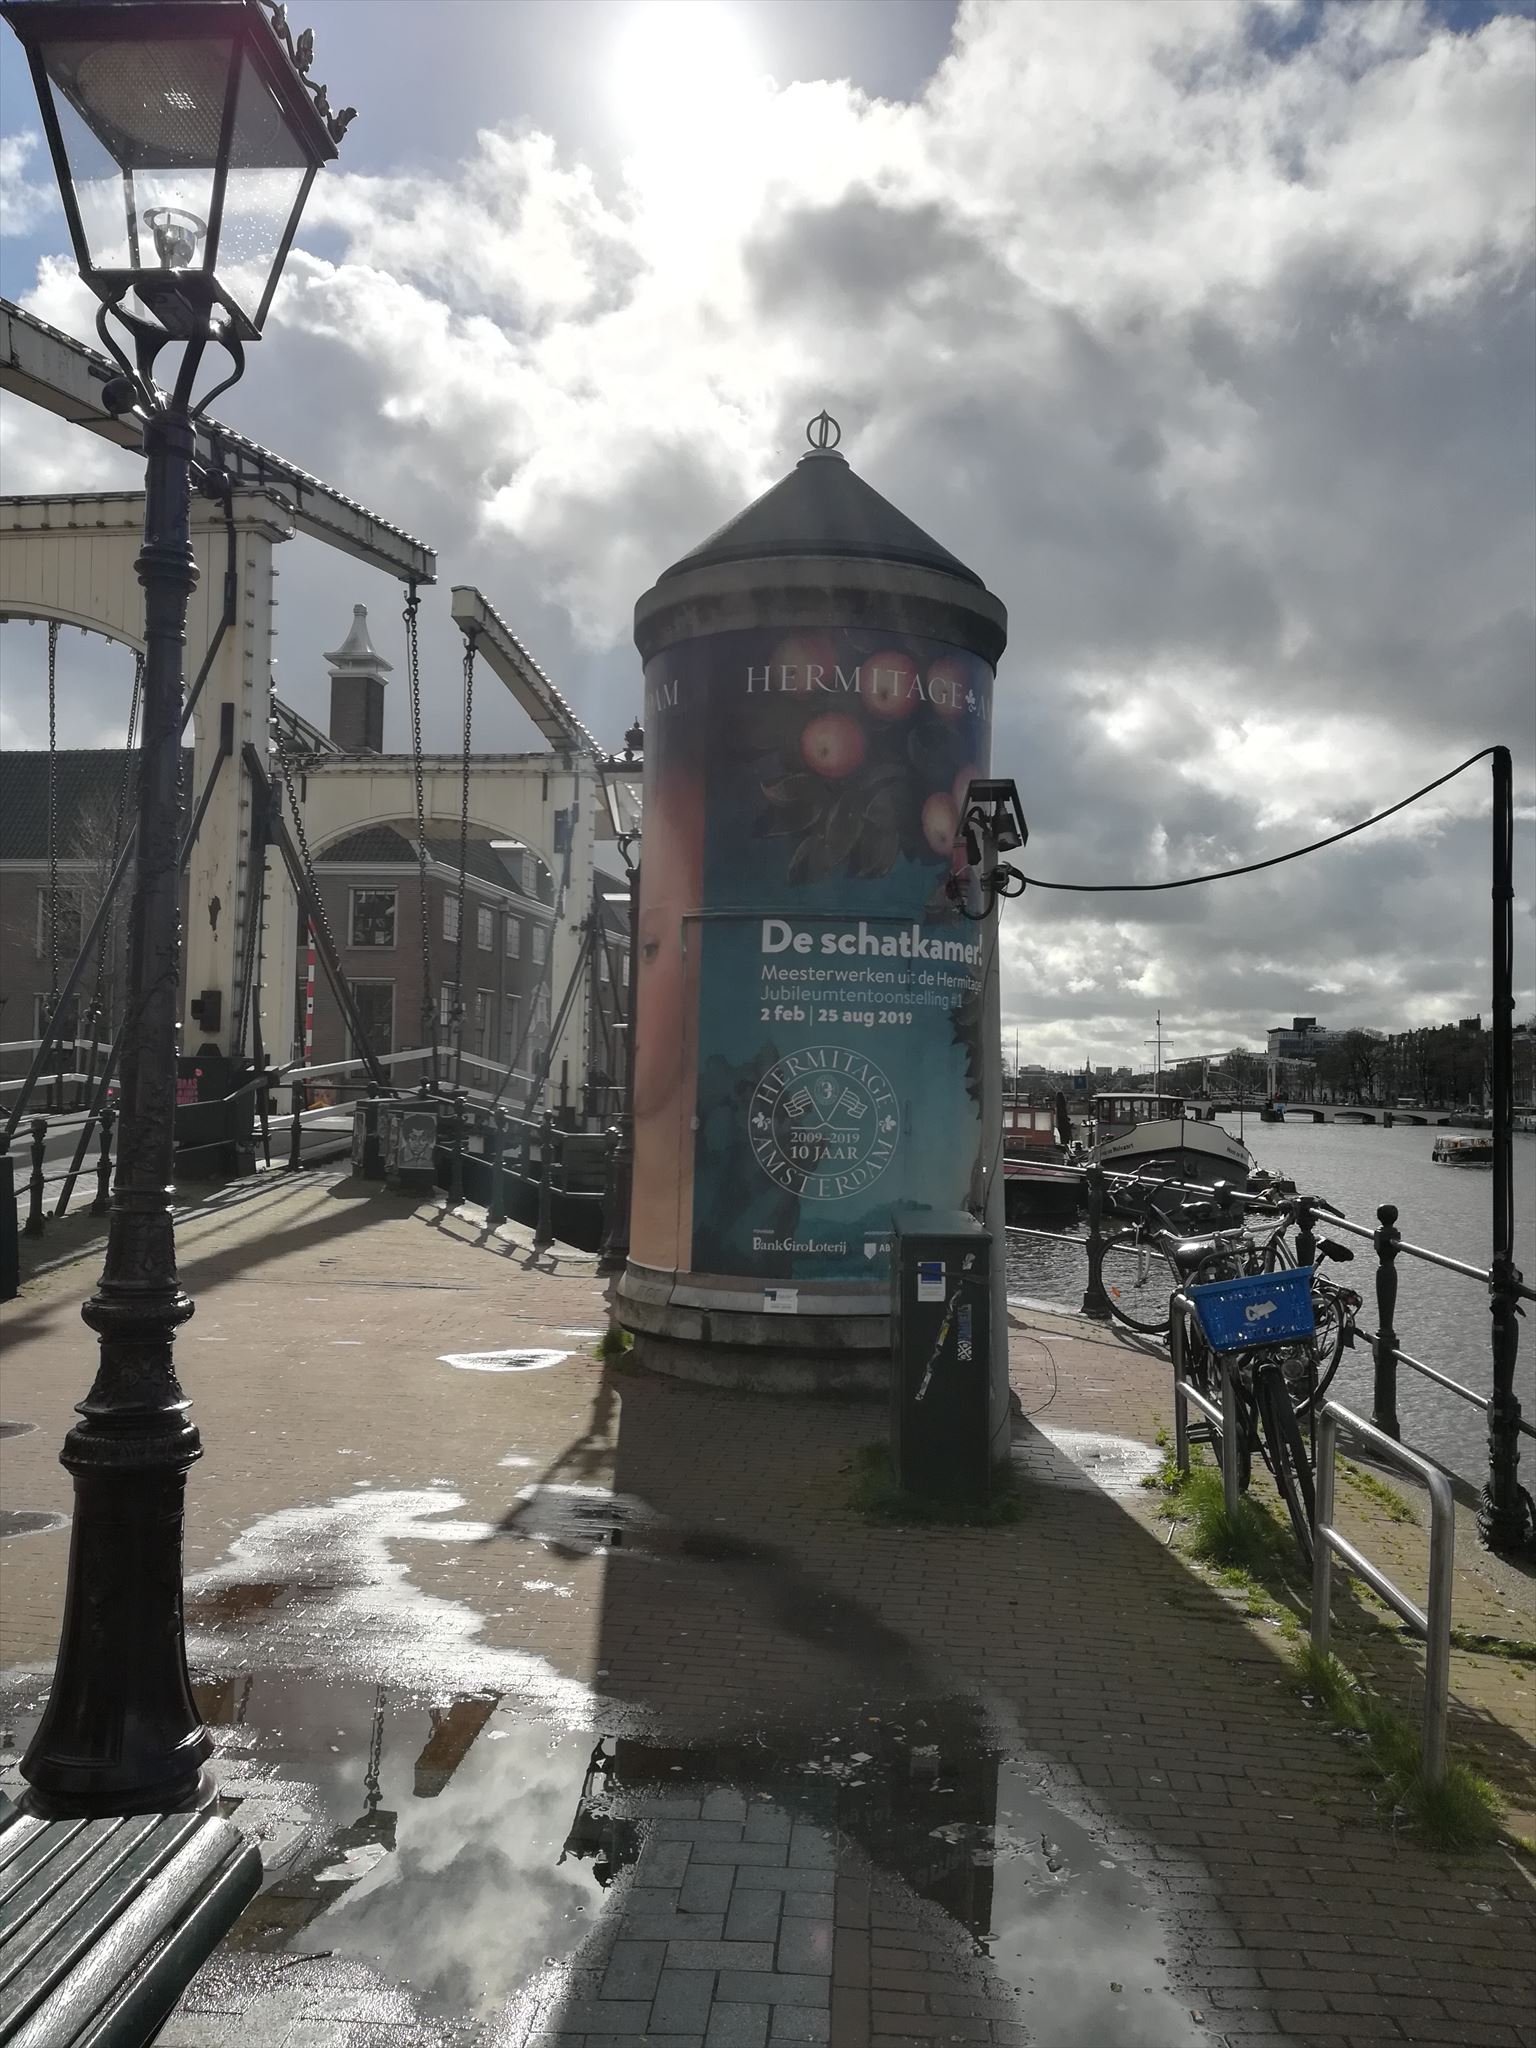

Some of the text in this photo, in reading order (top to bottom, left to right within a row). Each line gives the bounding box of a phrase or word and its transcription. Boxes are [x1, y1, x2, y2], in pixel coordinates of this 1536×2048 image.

[746, 664, 963, 710] HERMITAGE
[762, 919, 813, 953] De
[761, 965, 984, 996] Meesterwerken uit de Hermitage
[760, 985, 949, 1010] Jubileumtentoonstelling
[760, 1005, 912, 1027] 2 feb 25 aug 2019
[757, 1049, 894, 1109] HERMITAGE
[753, 1137, 893, 1198] AMSTERDAM
[790, 1145, 860, 1162] 10 JAAR
[753, 1237, 847, 1255] BankGiroLoterij
